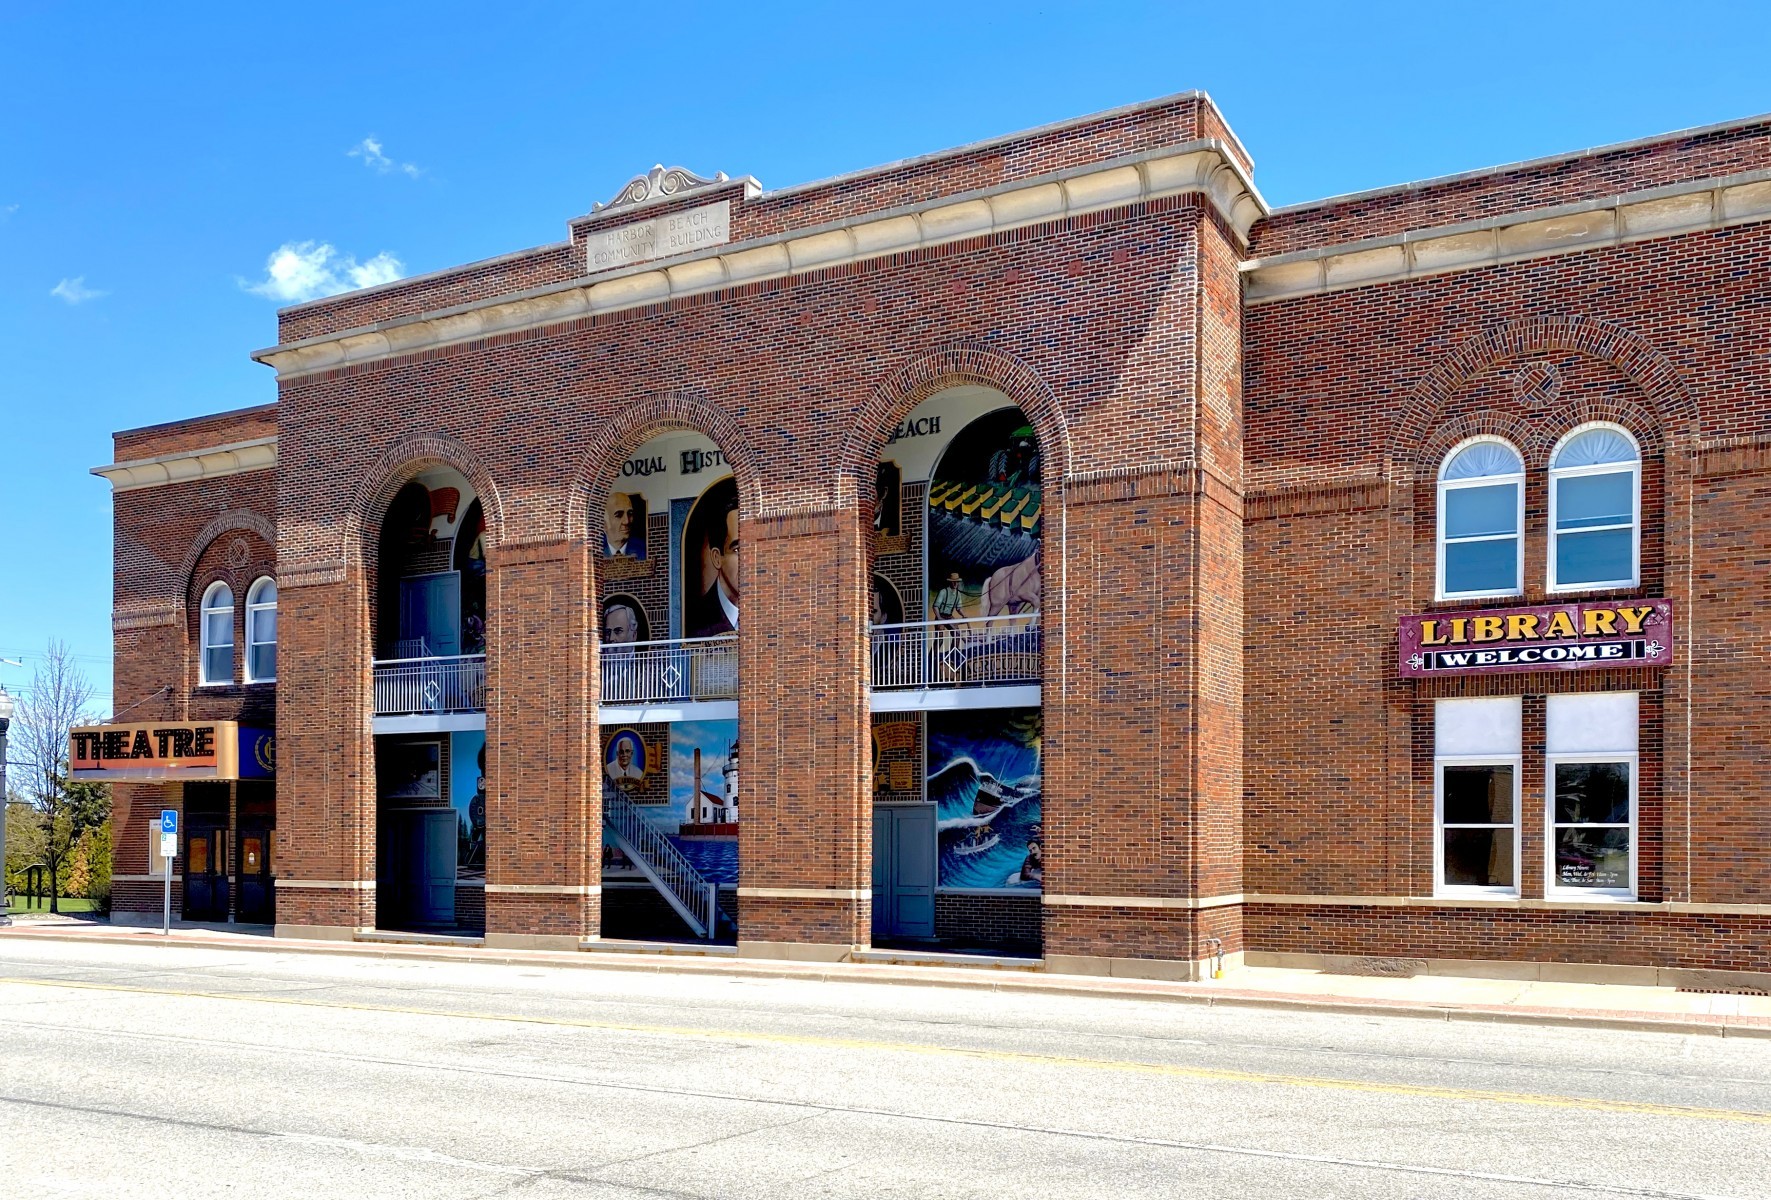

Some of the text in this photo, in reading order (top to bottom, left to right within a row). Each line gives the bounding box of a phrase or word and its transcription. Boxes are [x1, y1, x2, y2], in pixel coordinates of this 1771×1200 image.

[594, 225, 722, 265] COMMUNITY BUILDING
[606, 211, 708, 246] HARBOR BEACH
[888, 415, 942, 444] EACH
[616, 456, 667, 477] ORIAL
[1420, 606, 1653, 647] LIBRARY
[1441, 644, 1624, 667] WELCOME
[71, 727, 215, 760] THEATRE
